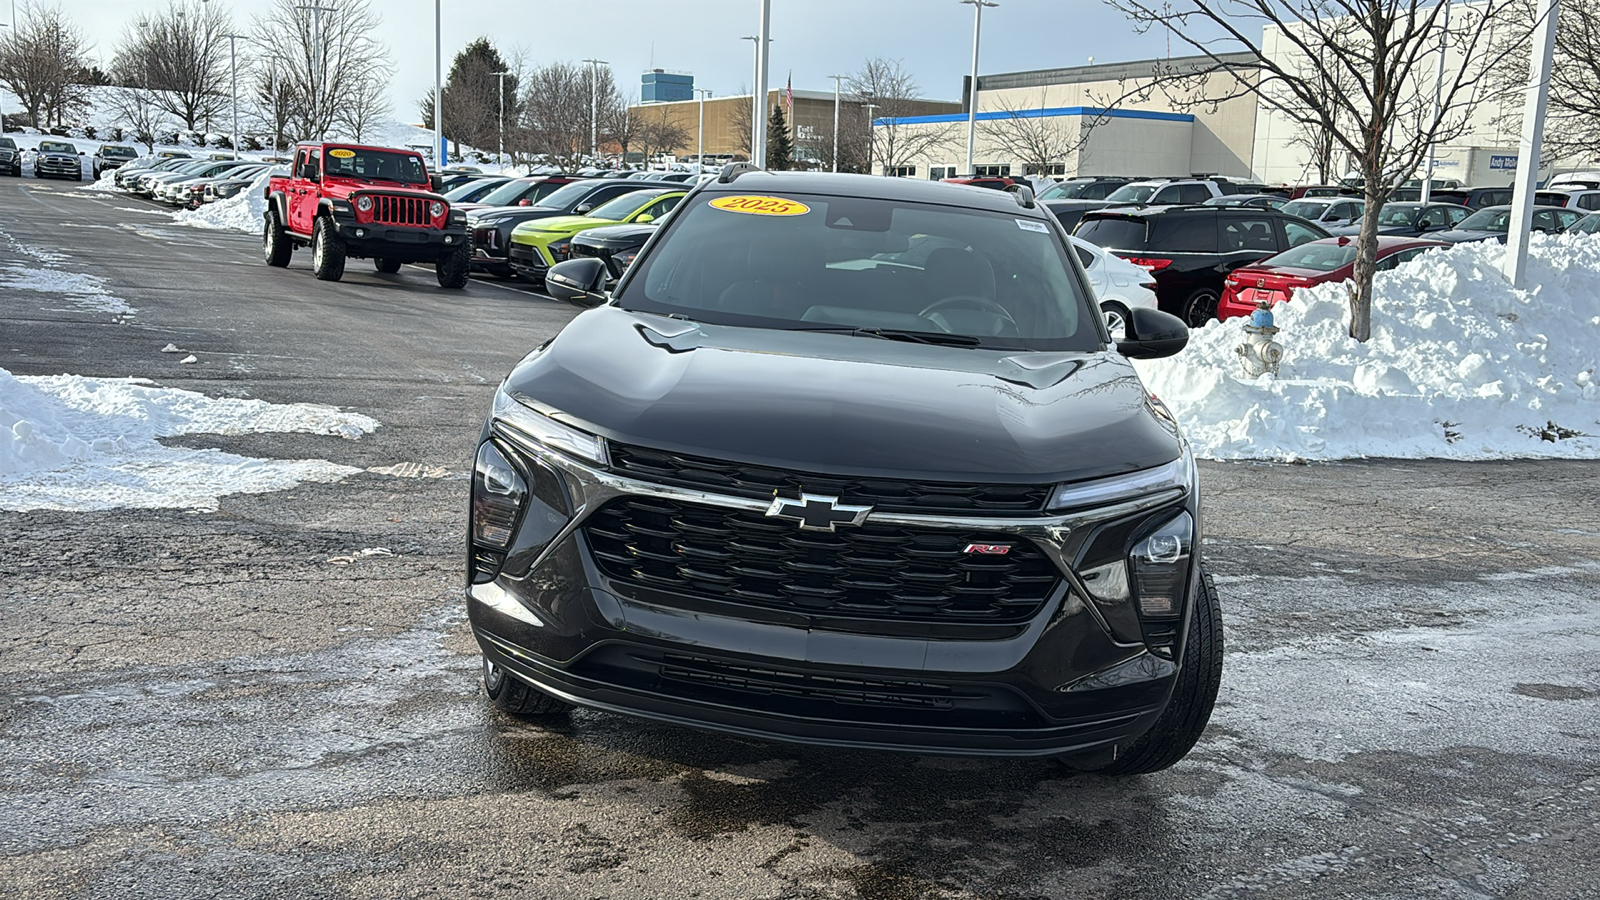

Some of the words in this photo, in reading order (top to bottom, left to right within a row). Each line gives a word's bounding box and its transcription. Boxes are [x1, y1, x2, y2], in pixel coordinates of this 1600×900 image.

[1491, 157, 1505, 168] Andy
[722, 197, 797, 213] 2025
[963, 543, 1012, 555] RS
